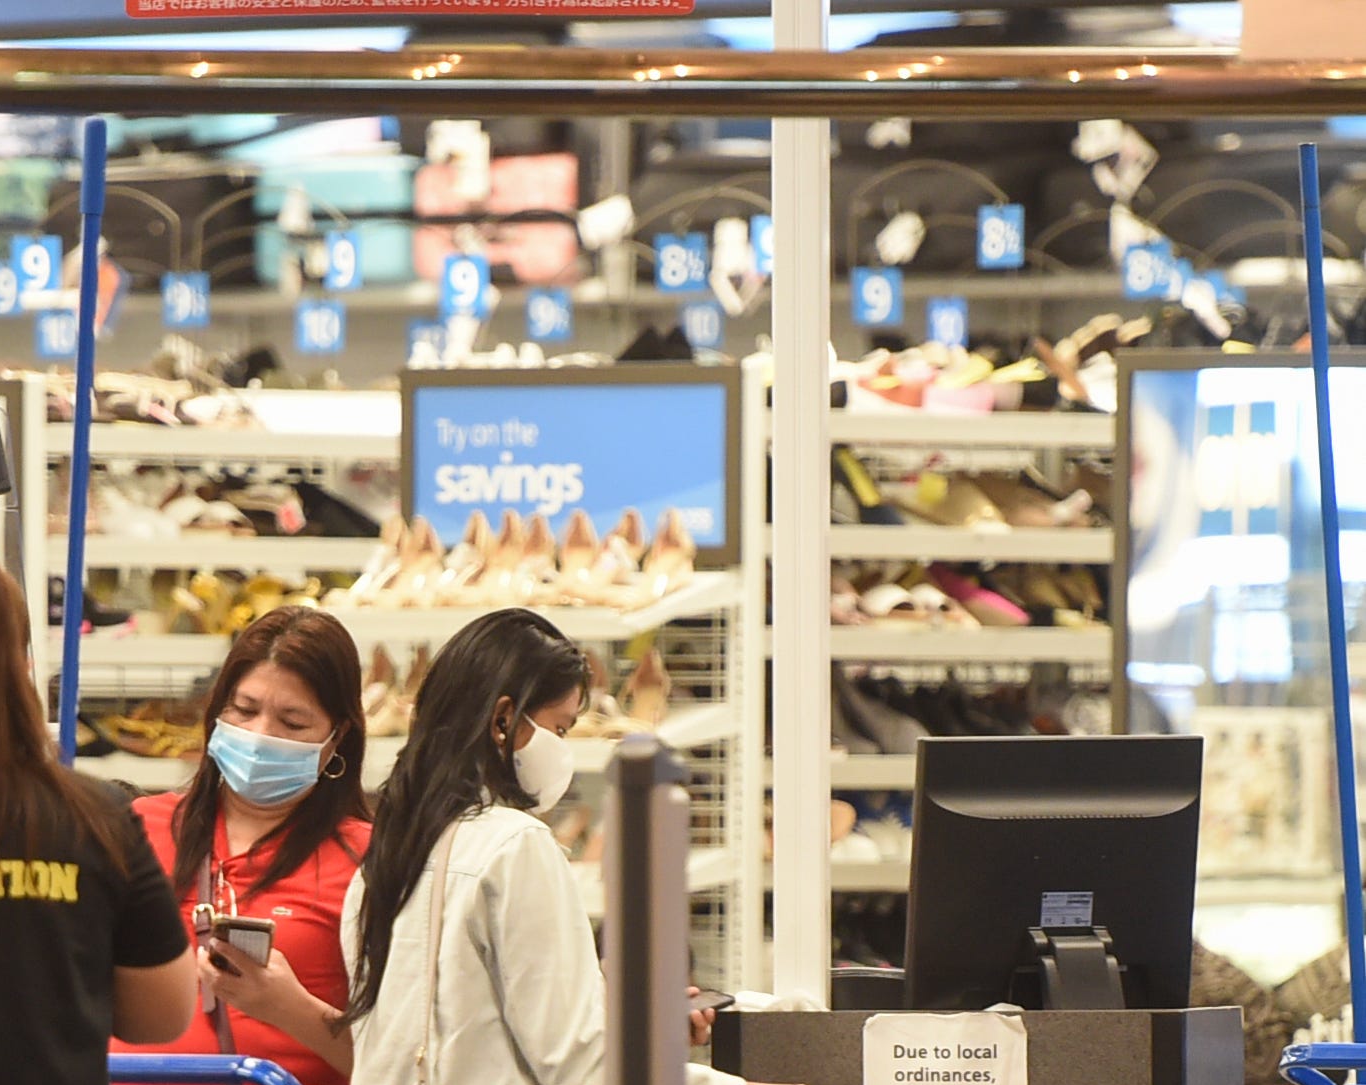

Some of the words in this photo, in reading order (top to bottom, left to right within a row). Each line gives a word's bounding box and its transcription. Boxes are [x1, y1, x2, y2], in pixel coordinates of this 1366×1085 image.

[21, 243, 51, 291] 9
[331, 239, 356, 288] 9
[448, 259, 479, 308] 9
[862, 274, 893, 323] 9
[437, 416, 468, 454] Try
[470, 423, 499, 447] on
[502, 416, 539, 447] the
[435, 450, 584, 516] savings
[893, 1044, 928, 1060] Due
[934, 1046, 951, 1060] to
[957, 1043, 998, 1060] local
[894, 1066, 996, 1085] ordinances,
